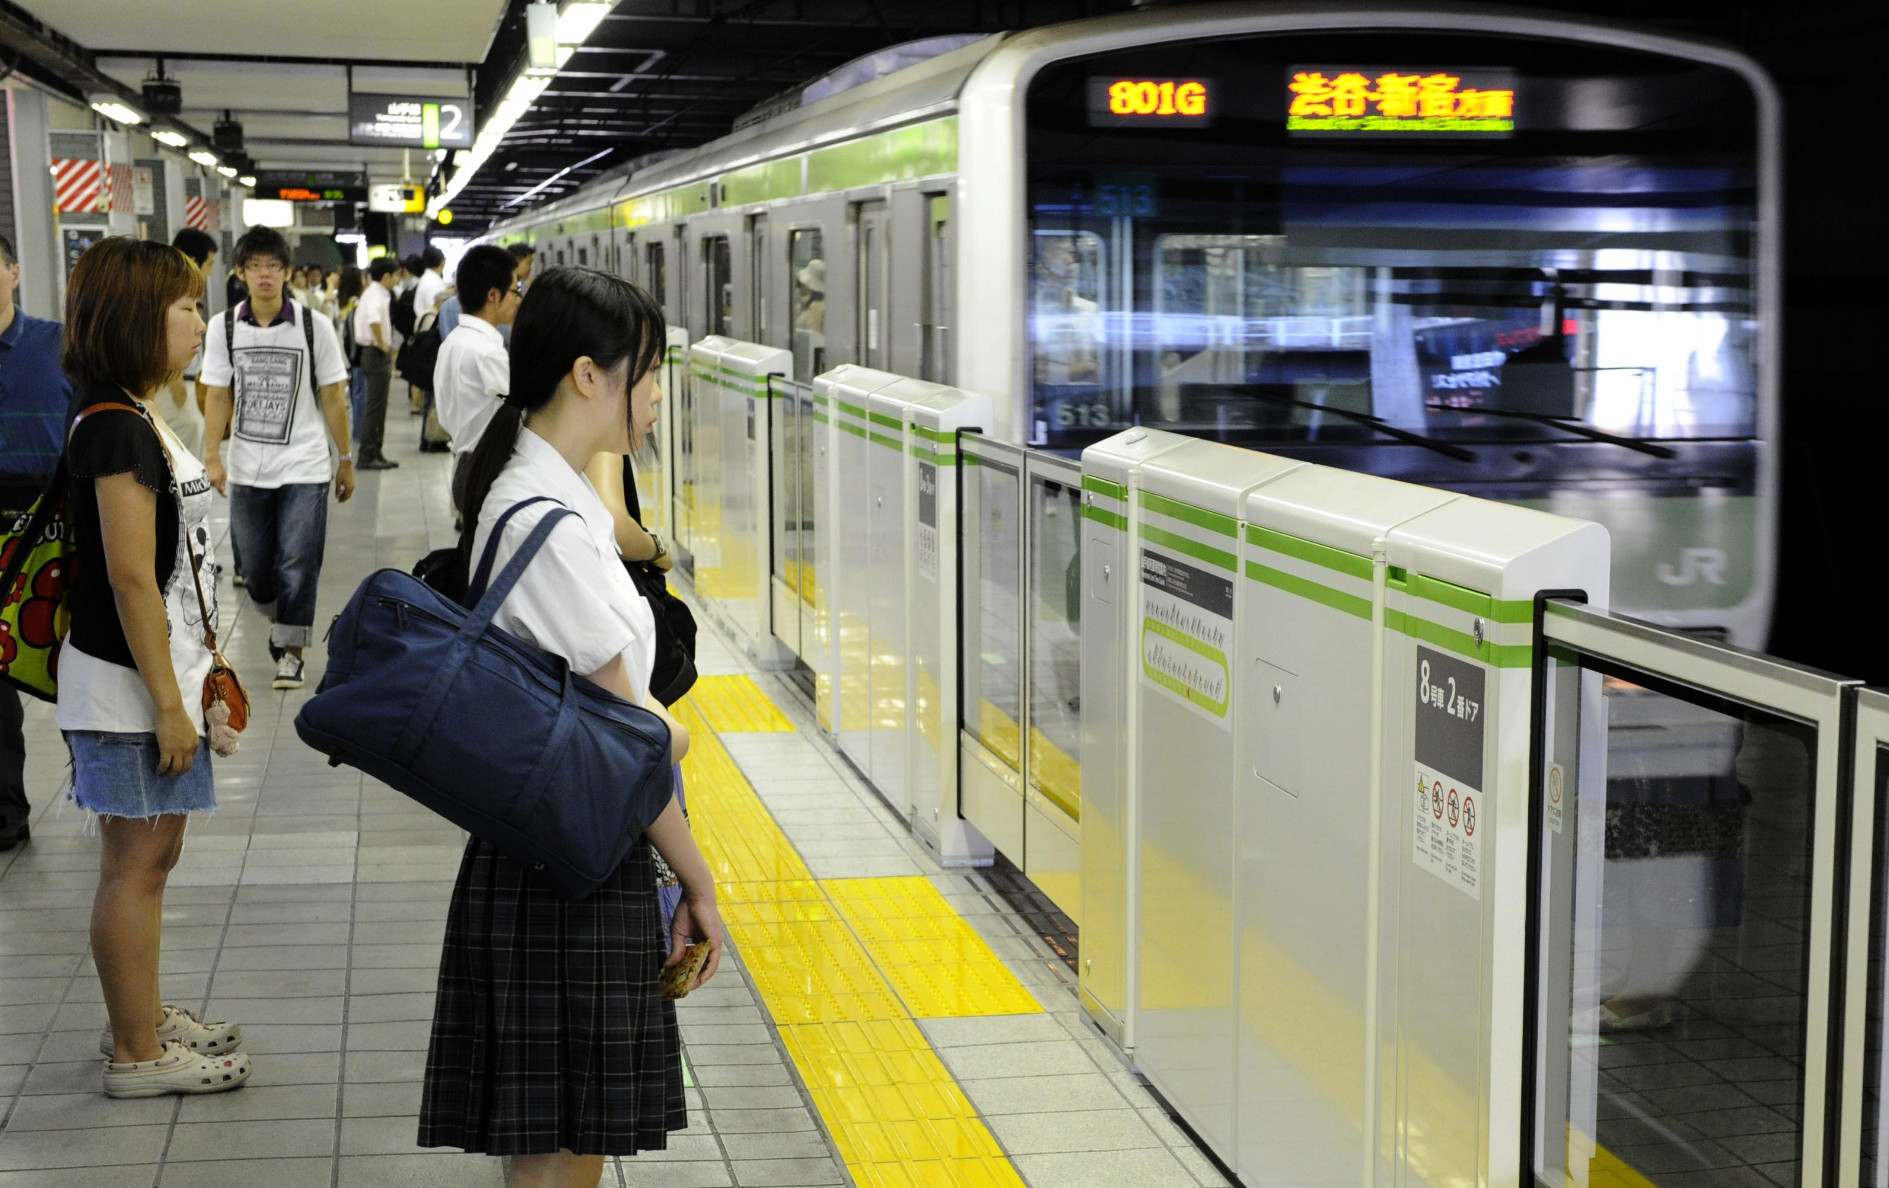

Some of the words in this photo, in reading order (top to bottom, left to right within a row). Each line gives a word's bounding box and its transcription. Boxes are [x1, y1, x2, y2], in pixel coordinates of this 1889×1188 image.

[1109, 81, 1206, 115] 801G
[440, 104, 463, 140] 2
[1056, 403, 1109, 426] 513
[1657, 547, 1727, 586] JR
